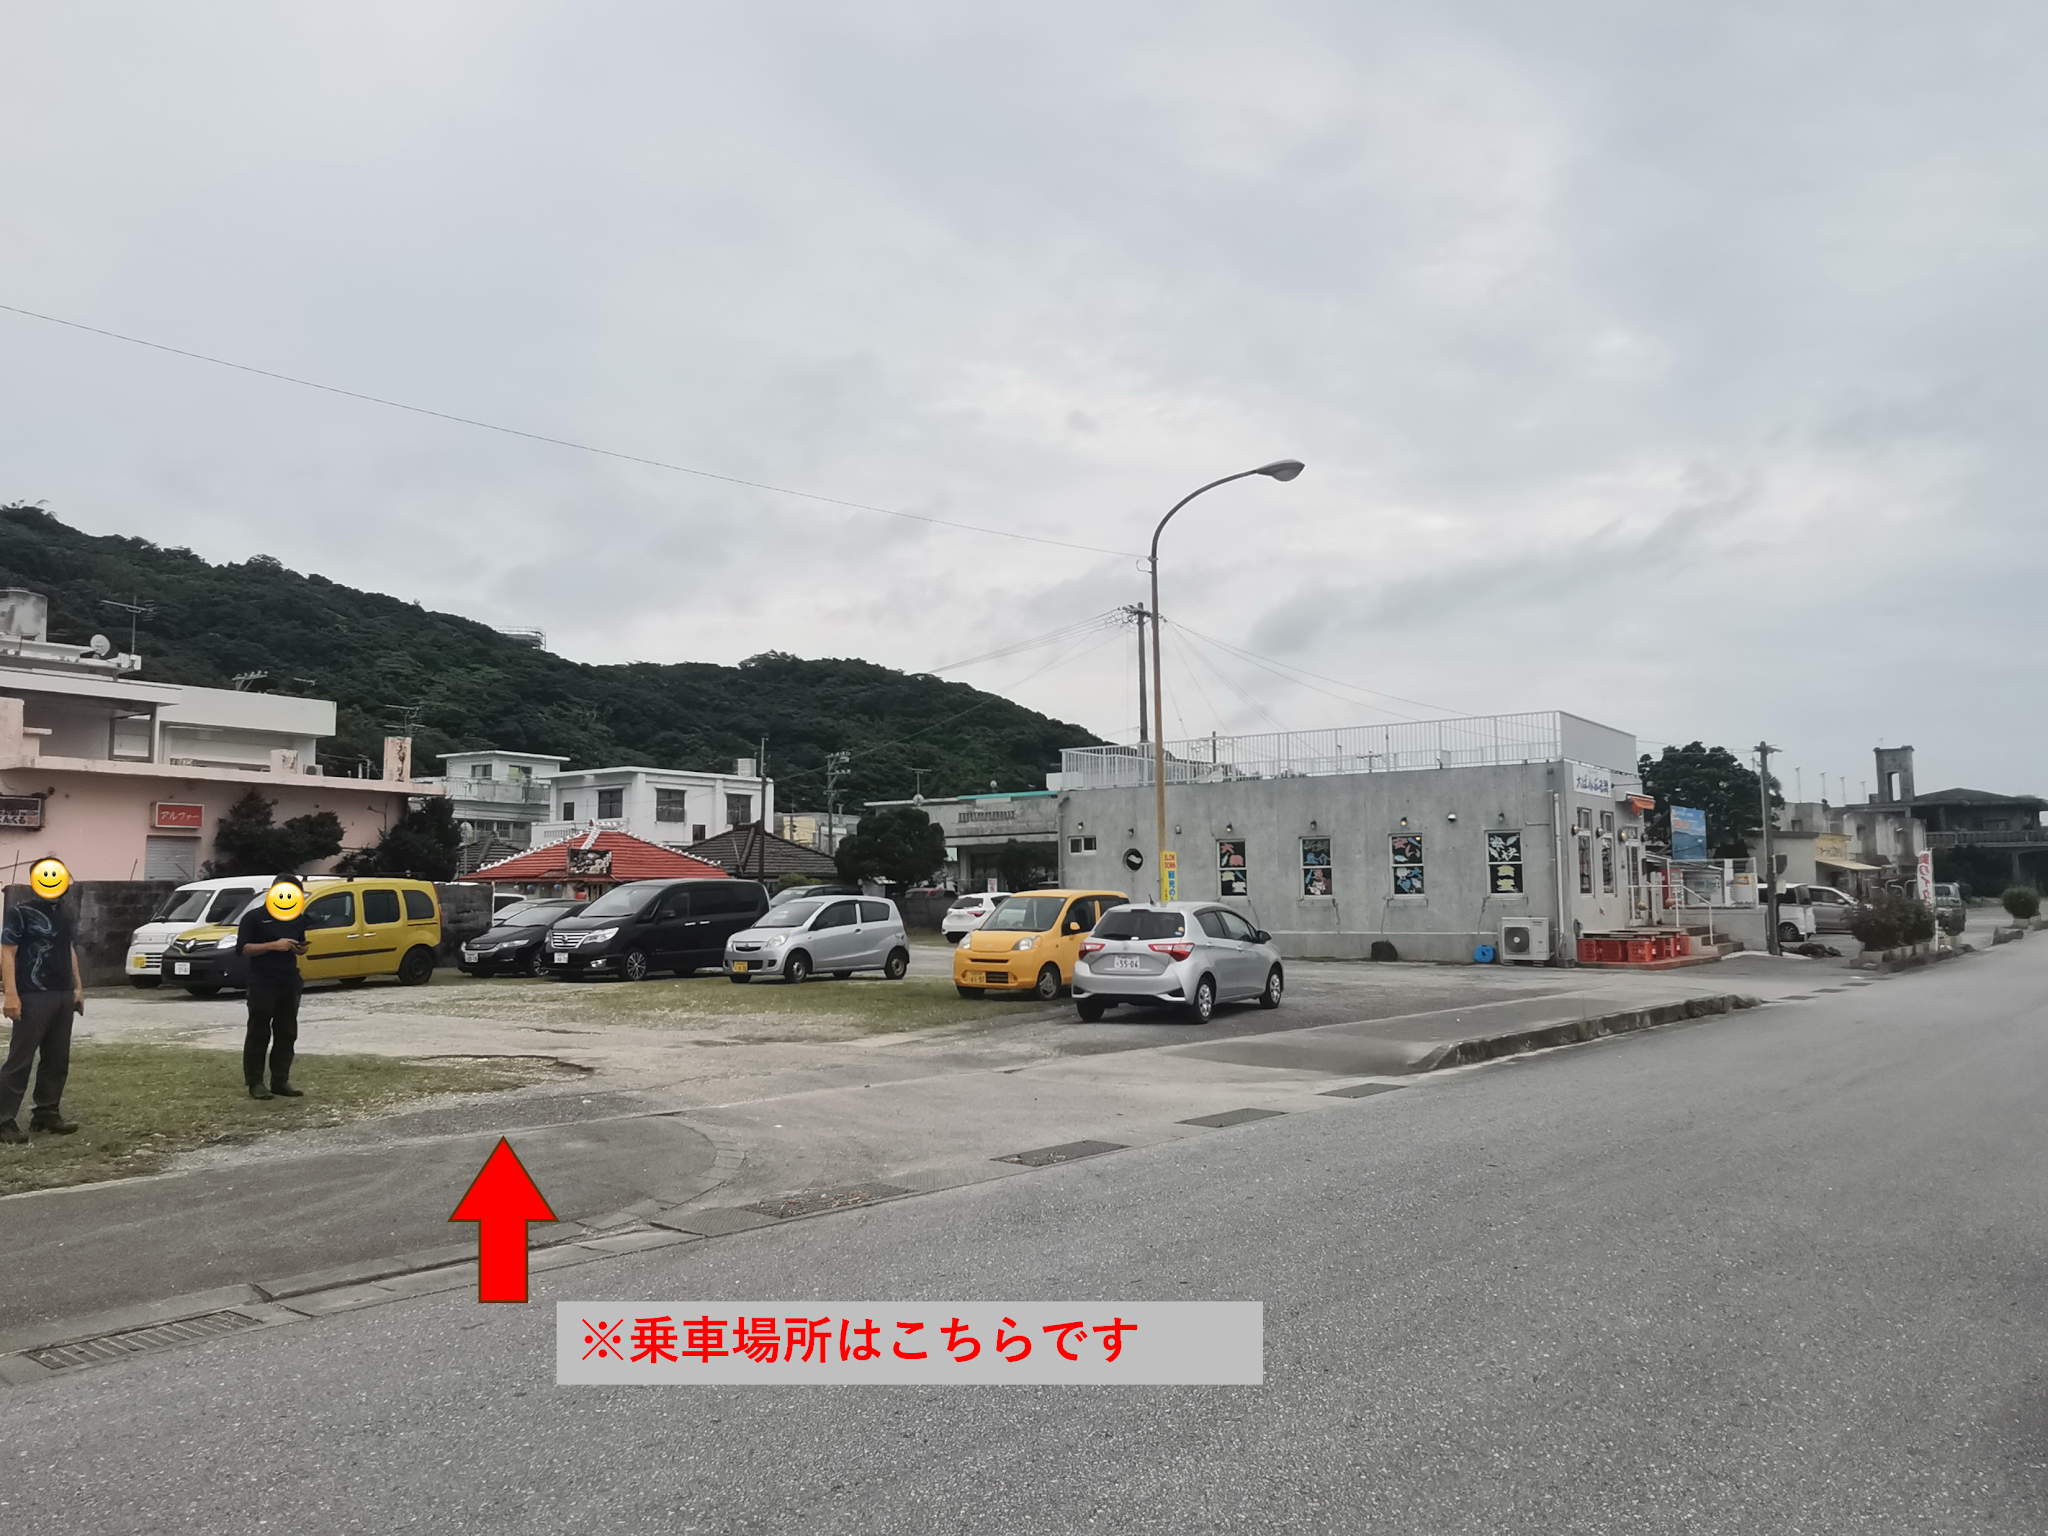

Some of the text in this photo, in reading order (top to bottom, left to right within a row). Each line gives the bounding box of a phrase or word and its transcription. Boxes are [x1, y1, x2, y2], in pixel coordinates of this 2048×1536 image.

[160, 810, 199, 821] アルファー
[1119, 960, 1139, 968] 55-06
